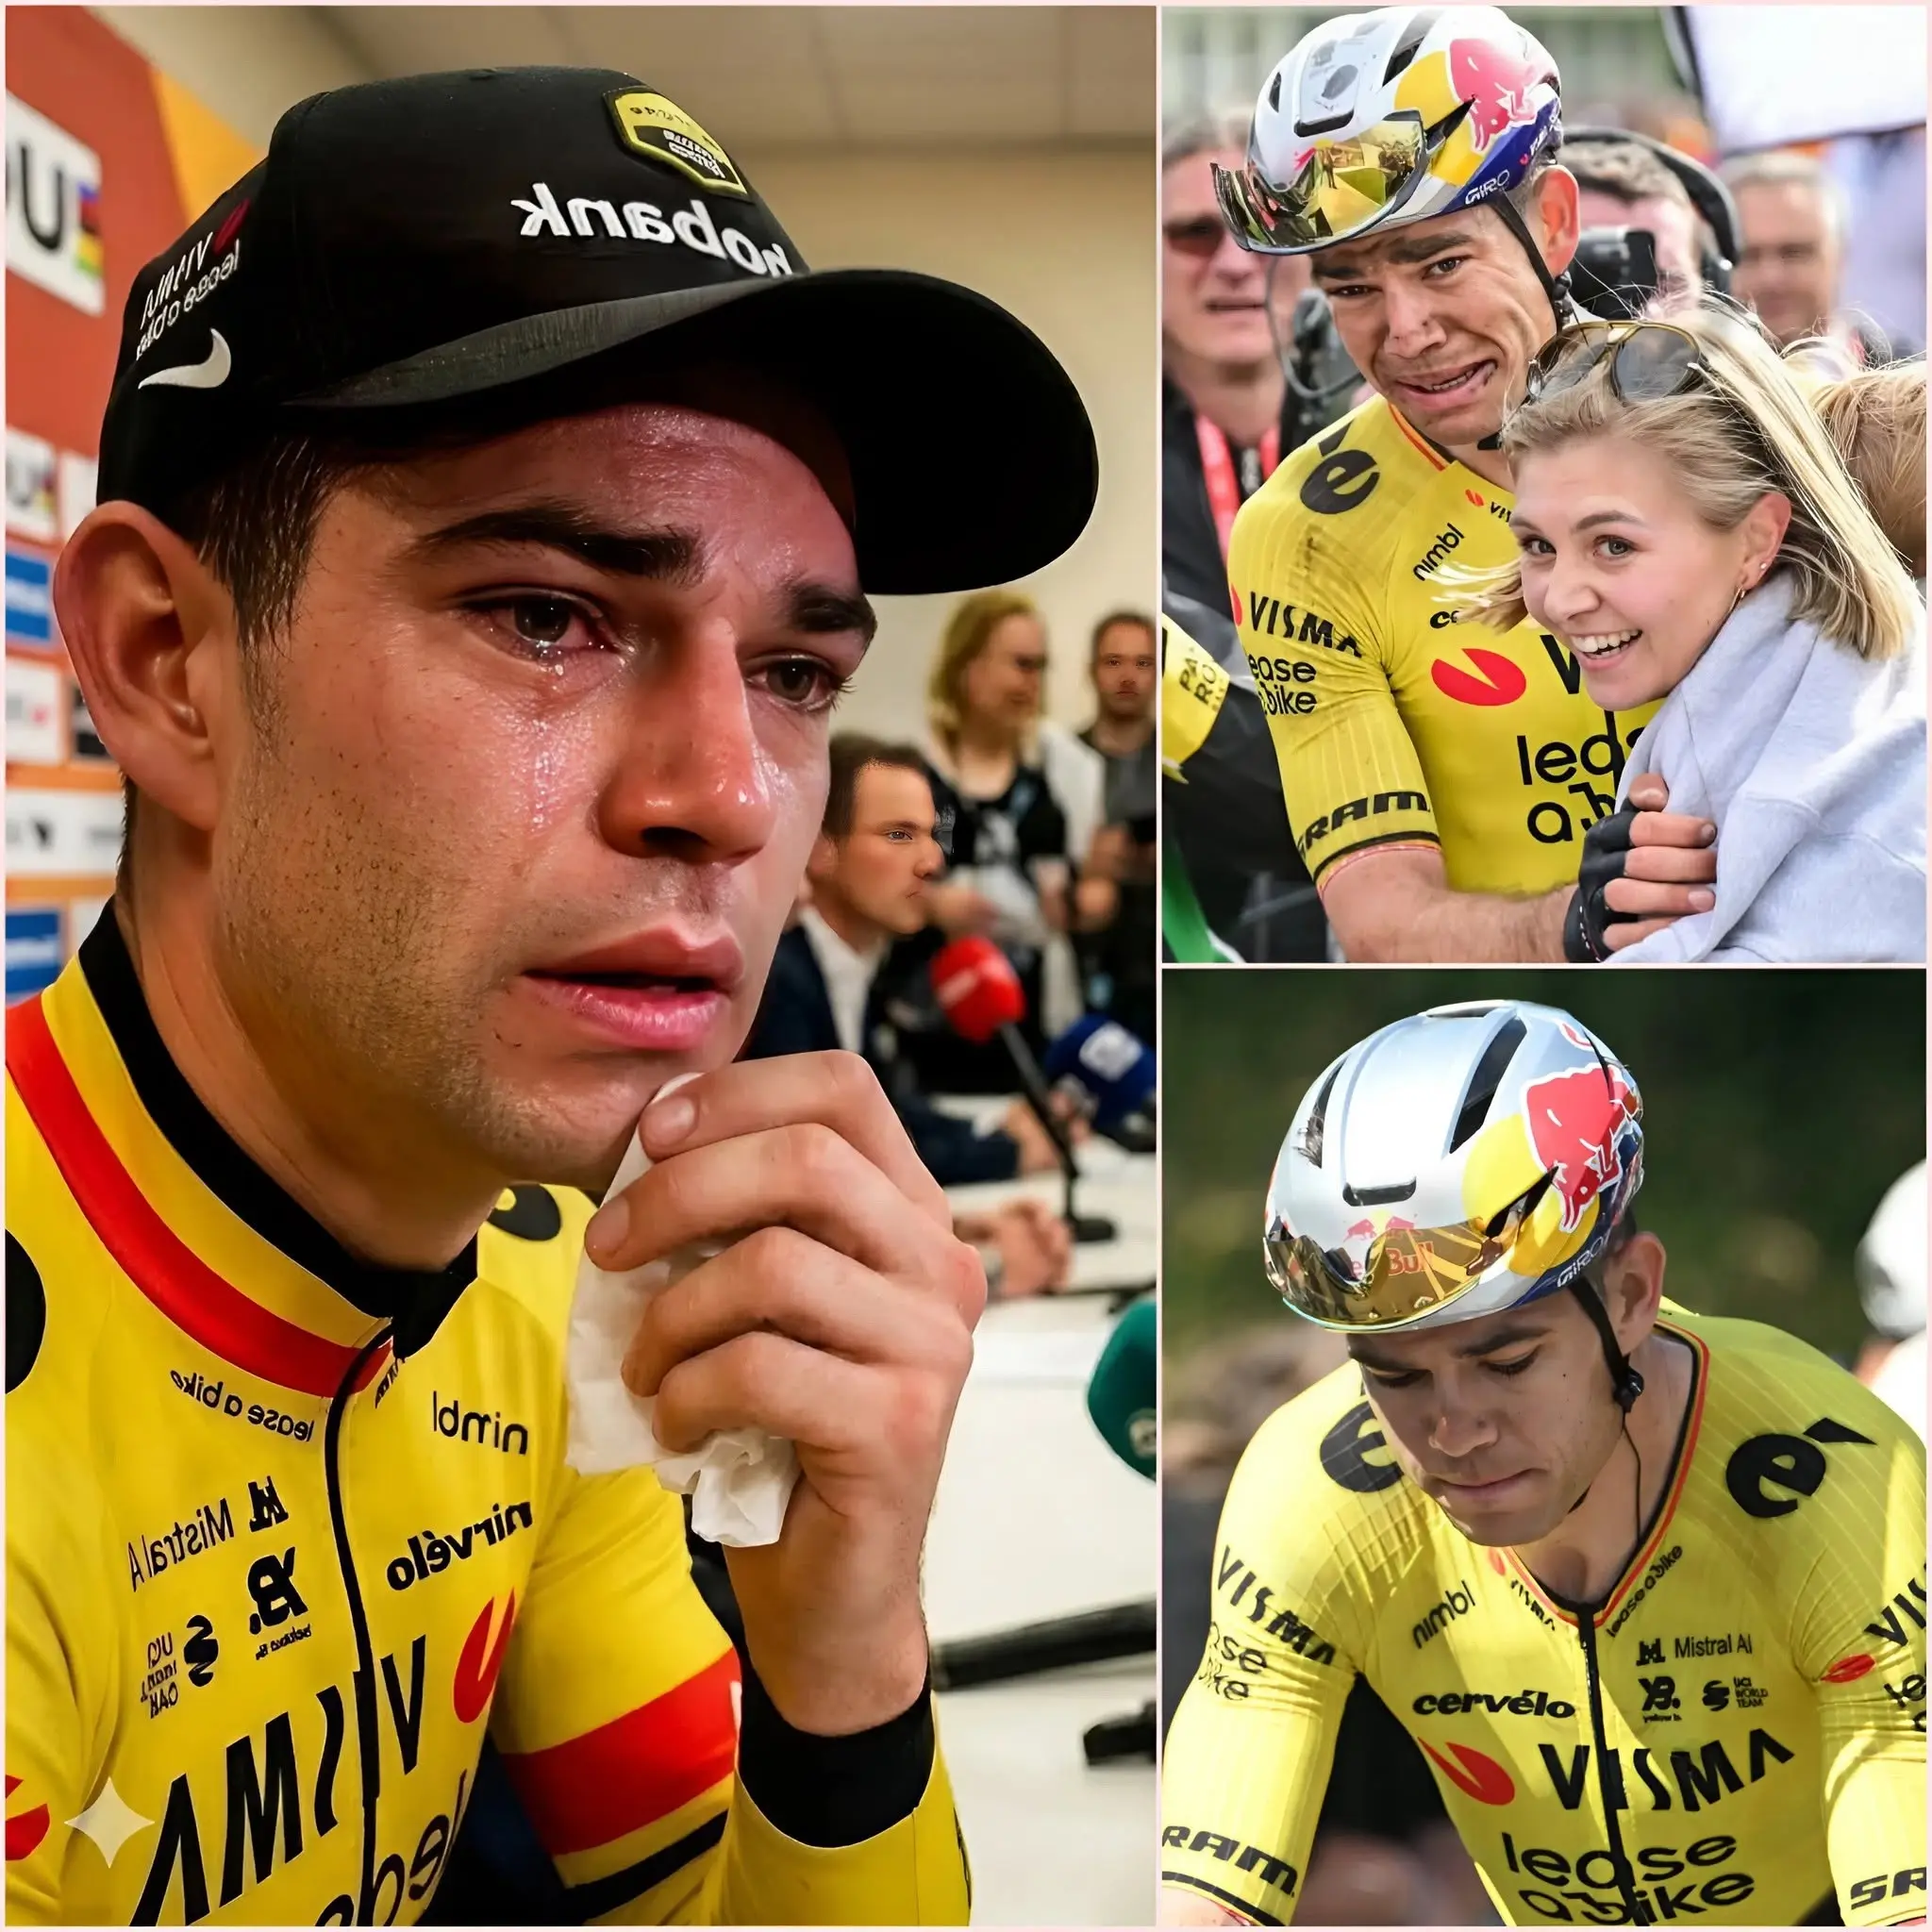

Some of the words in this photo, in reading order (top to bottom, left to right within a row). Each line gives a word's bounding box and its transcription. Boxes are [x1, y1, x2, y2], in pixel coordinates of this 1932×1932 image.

[1465, 169, 1510, 205] GIRO
[1413, 522, 1465, 582] nimbl
[1250, 591, 1362, 658] VISMA
[1557, 1234, 1604, 1288] GIRO
[1218, 1544, 1337, 1666] VISMA
[1411, 1579, 1476, 1650] nimbl
[1674, 1634, 1733, 1659] Mistral
[1737, 1633, 1754, 1655] AI
[1411, 1689, 1576, 1719] cervélo
[1737, 1697, 1764, 1708] TEAM
[1538, 1727, 1796, 1812] VISMA
[1501, 1832, 1738, 1890] lease
